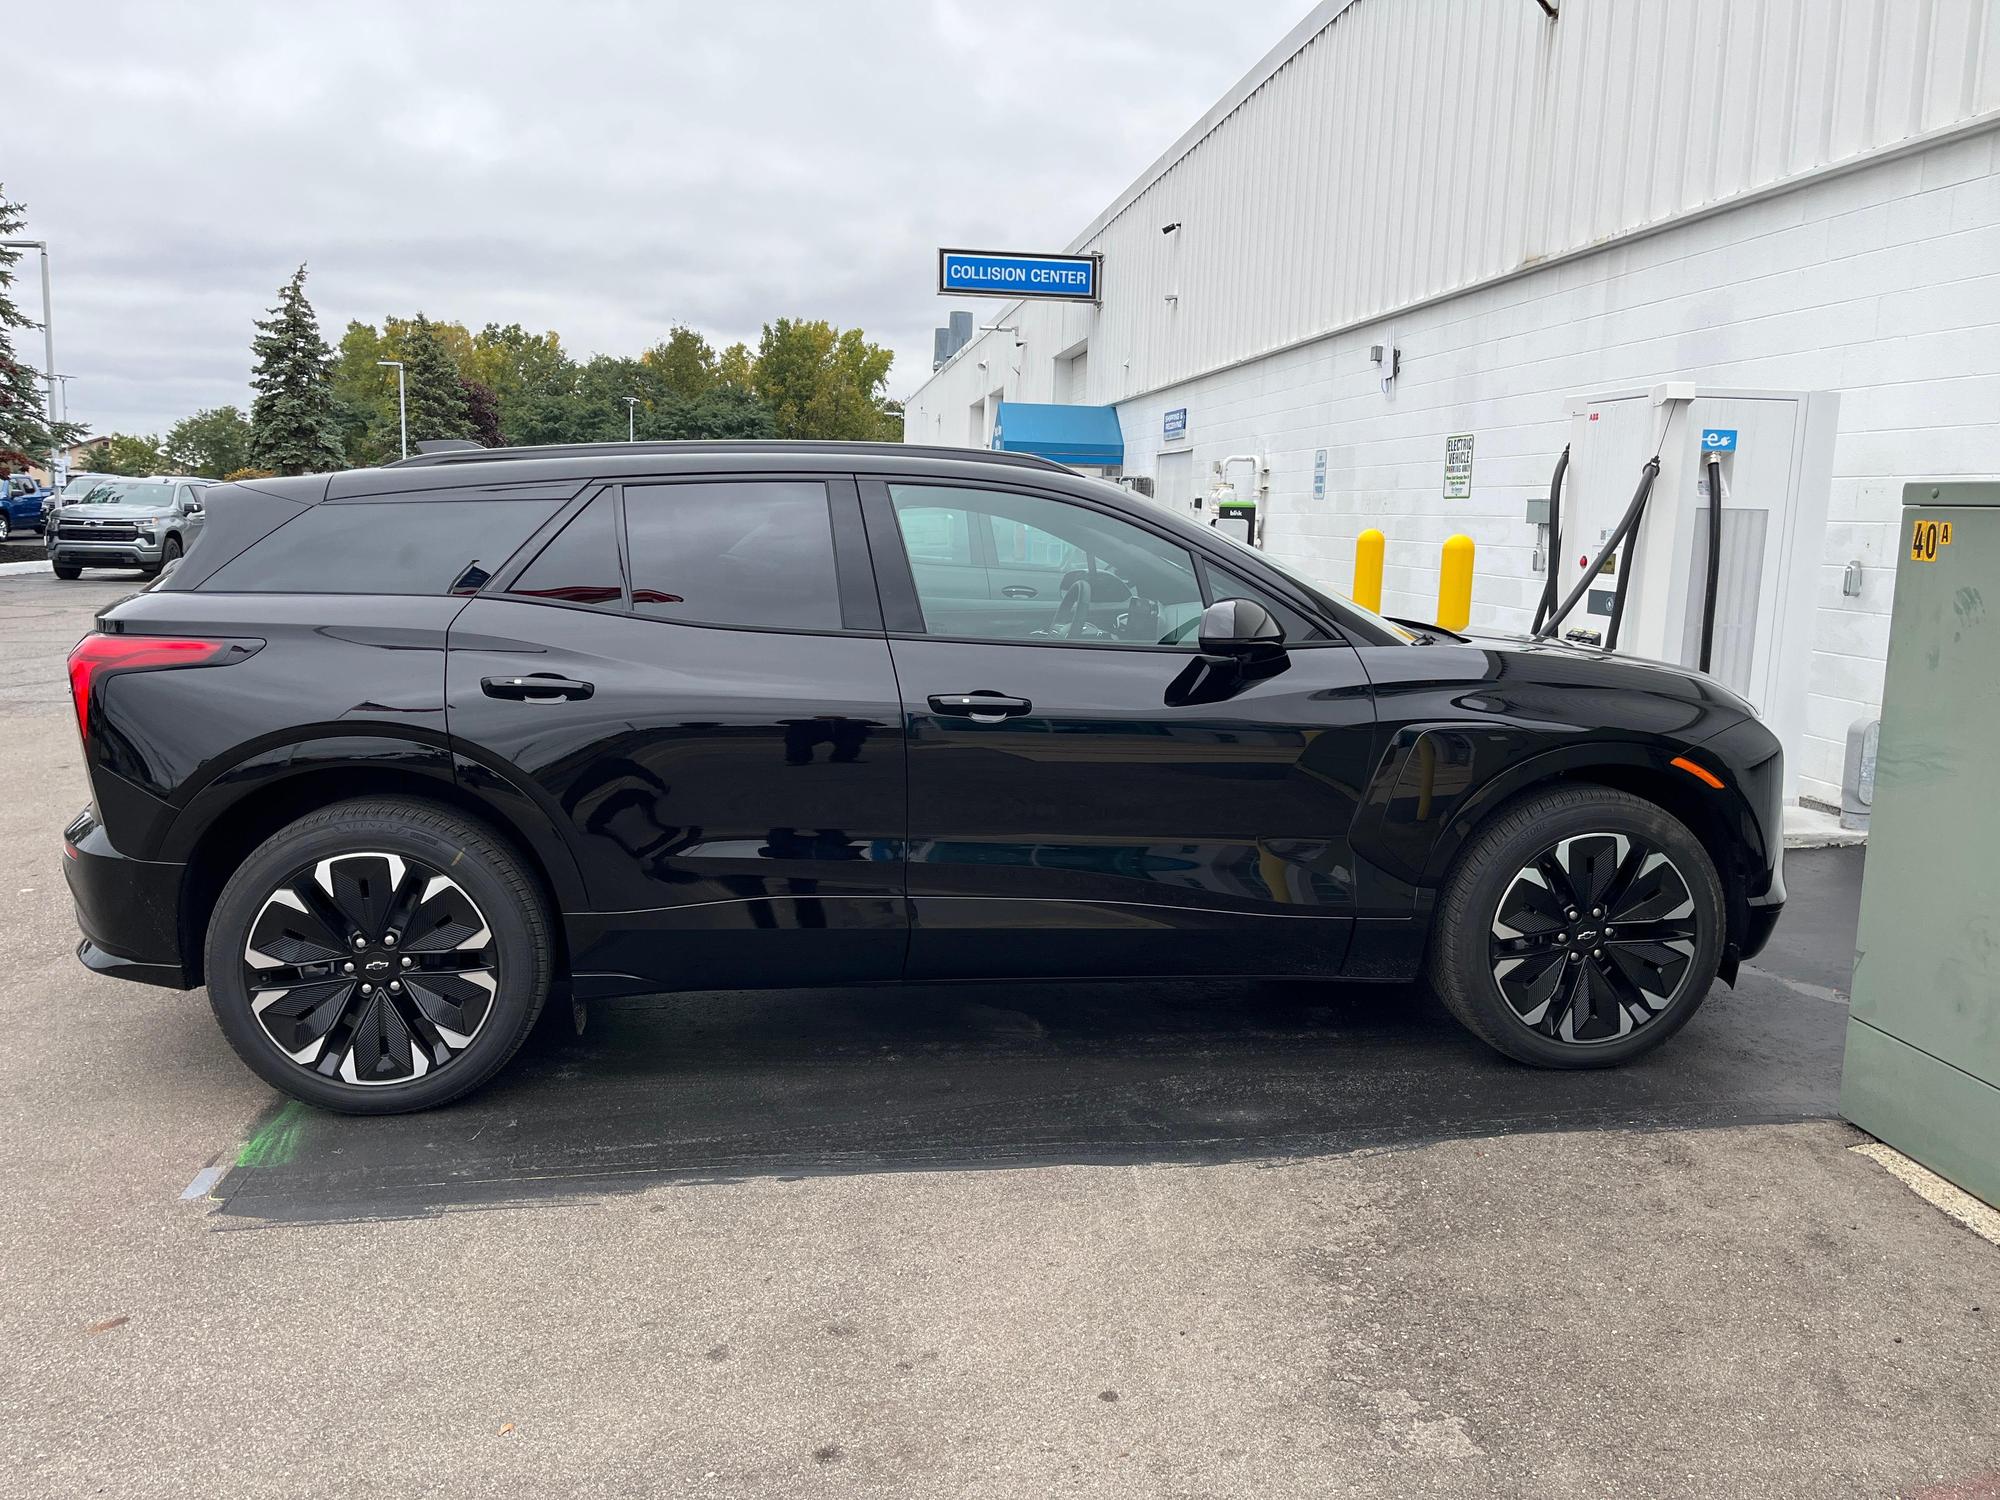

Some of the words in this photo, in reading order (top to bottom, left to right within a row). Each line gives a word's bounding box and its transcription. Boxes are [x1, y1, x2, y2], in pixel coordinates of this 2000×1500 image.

[951, 264, 1026, 282] COLLISION
[1031, 269, 1086, 285] CENTER
[1448, 438, 1472, 452] ELECTRIC
[1448, 451, 1470, 464] VEHICLE
